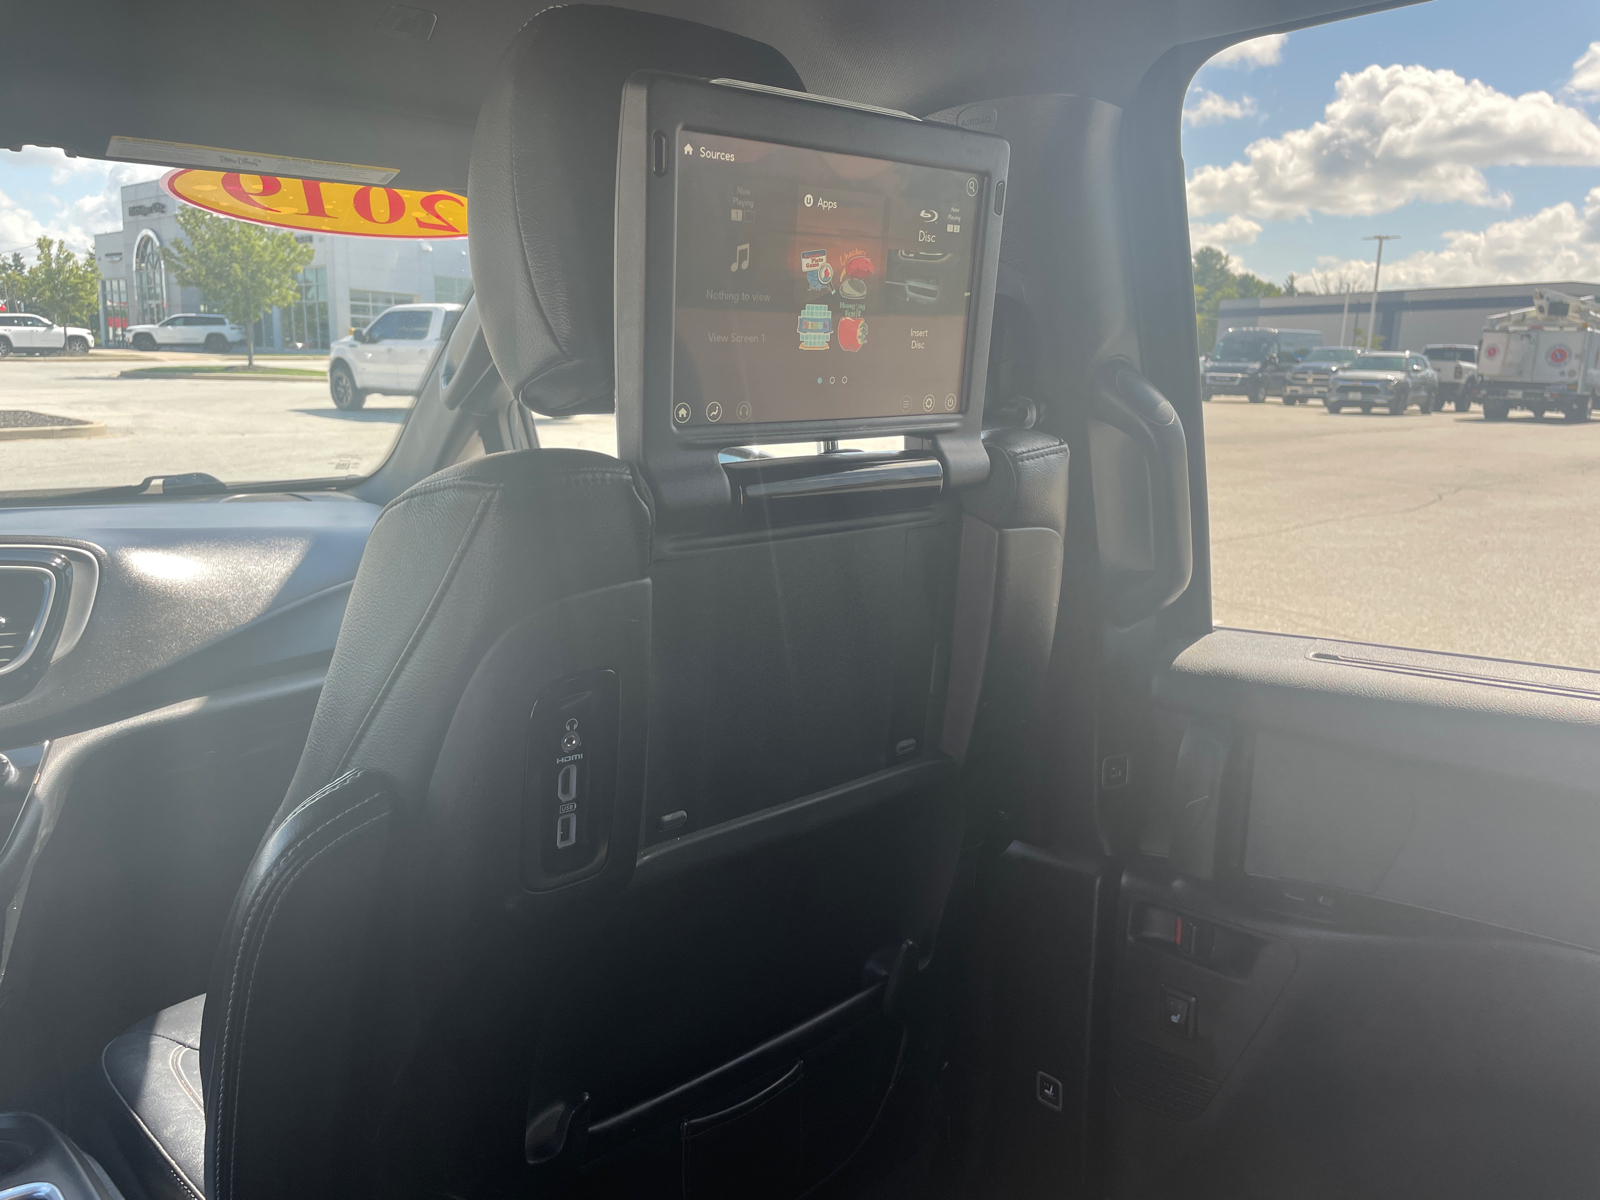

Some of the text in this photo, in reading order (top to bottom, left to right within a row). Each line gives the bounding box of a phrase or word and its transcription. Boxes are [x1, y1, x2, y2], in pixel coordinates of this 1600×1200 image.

[961, 115, 992, 127] AIRBAG
[699, 146, 735, 162] Sources
[732, 197, 755, 209] Playing
[817, 197, 838, 211] Apps
[918, 230, 936, 243] Disc
[706, 289, 771, 303] Nothing to view
[708, 332, 728, 343] View
[730, 333, 758, 343] Screen
[910, 328, 928, 338] Insert
[911, 340, 925, 349] Disc
[556, 753, 584, 764] HDMI
[561, 803, 574, 812] USB
